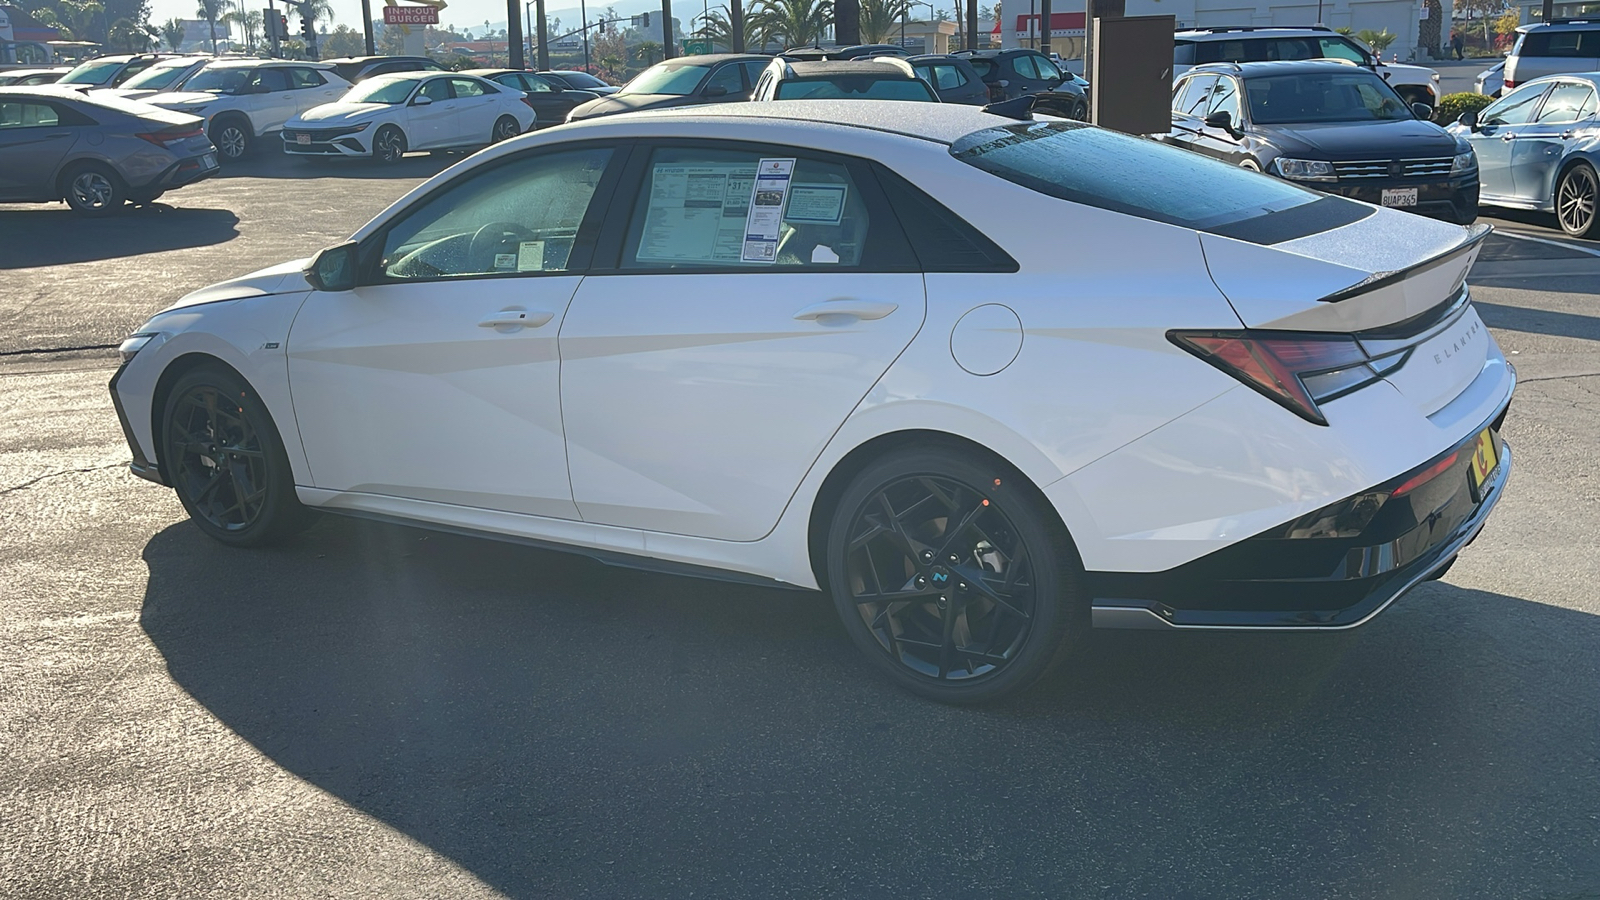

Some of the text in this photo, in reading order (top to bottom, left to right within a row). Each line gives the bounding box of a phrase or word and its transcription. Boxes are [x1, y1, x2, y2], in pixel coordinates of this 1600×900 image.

[388, 7, 436, 15] IN-N-OUT
[389, 15, 436, 23] BURGER
[732, 181, 741, 190] 31
[1383, 194, 1416, 205] 8UAP365
[1433, 321, 1480, 365] ELANTRA
[932, 572, 948, 582] N
